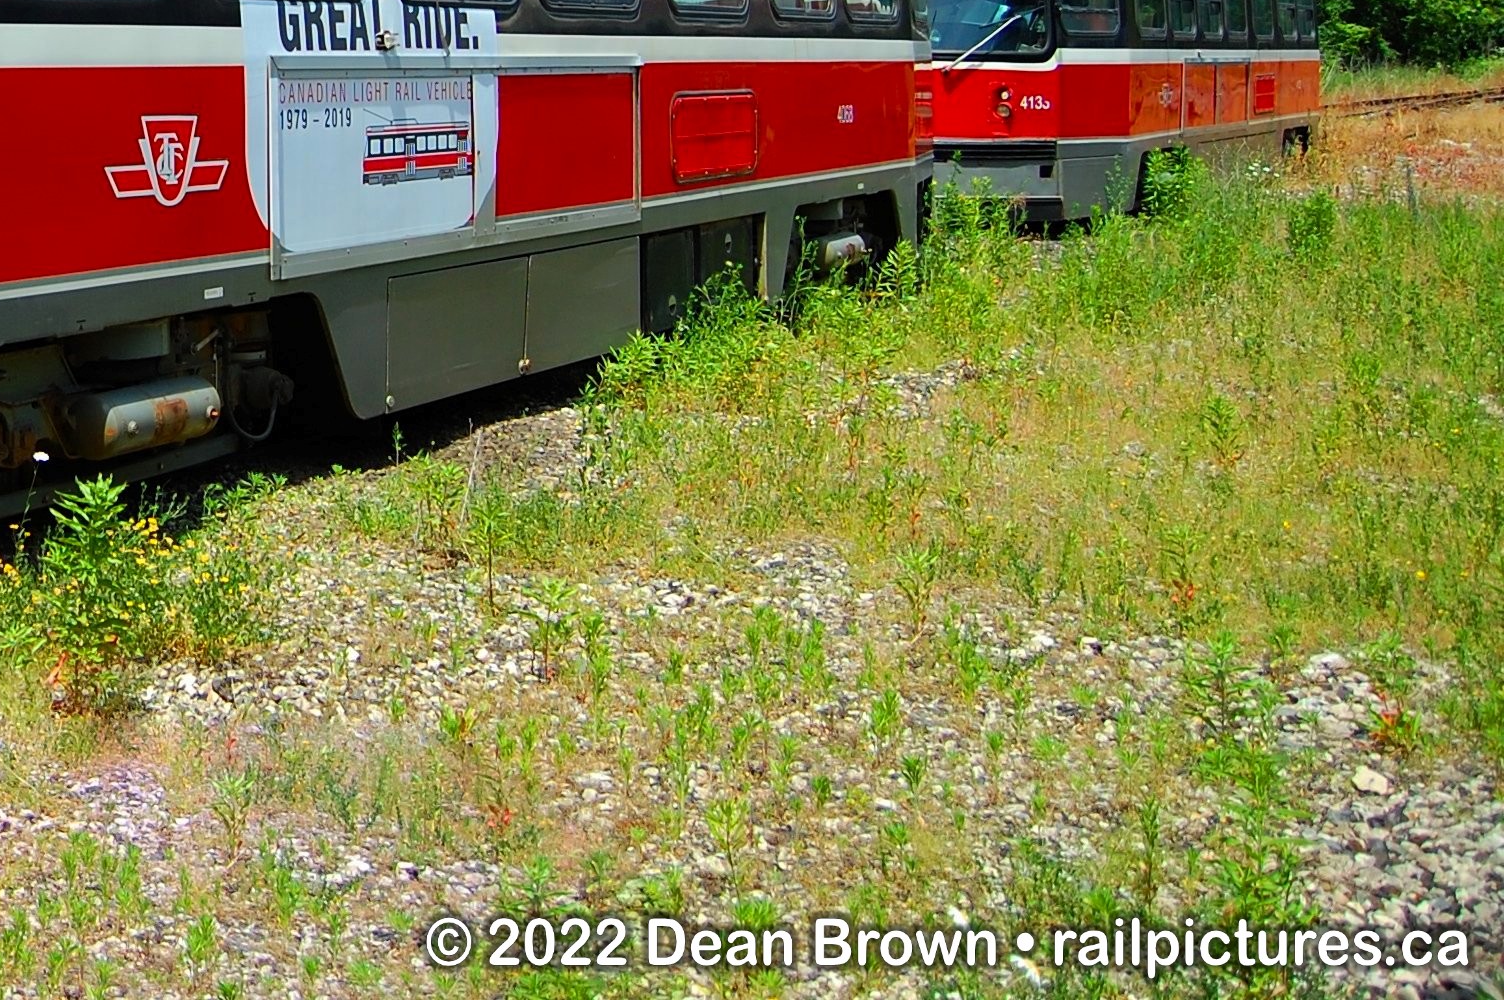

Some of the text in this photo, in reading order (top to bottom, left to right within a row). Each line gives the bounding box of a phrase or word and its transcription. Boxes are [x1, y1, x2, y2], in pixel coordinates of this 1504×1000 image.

[403, 4, 480, 50] RIDE.
[279, 82, 346, 105] CANADIAN
[353, 81, 389, 102] LIGHT
[396, 81, 421, 101] RAIL
[279, 108, 308, 130] 1979
[324, 107, 352, 128] 2019
